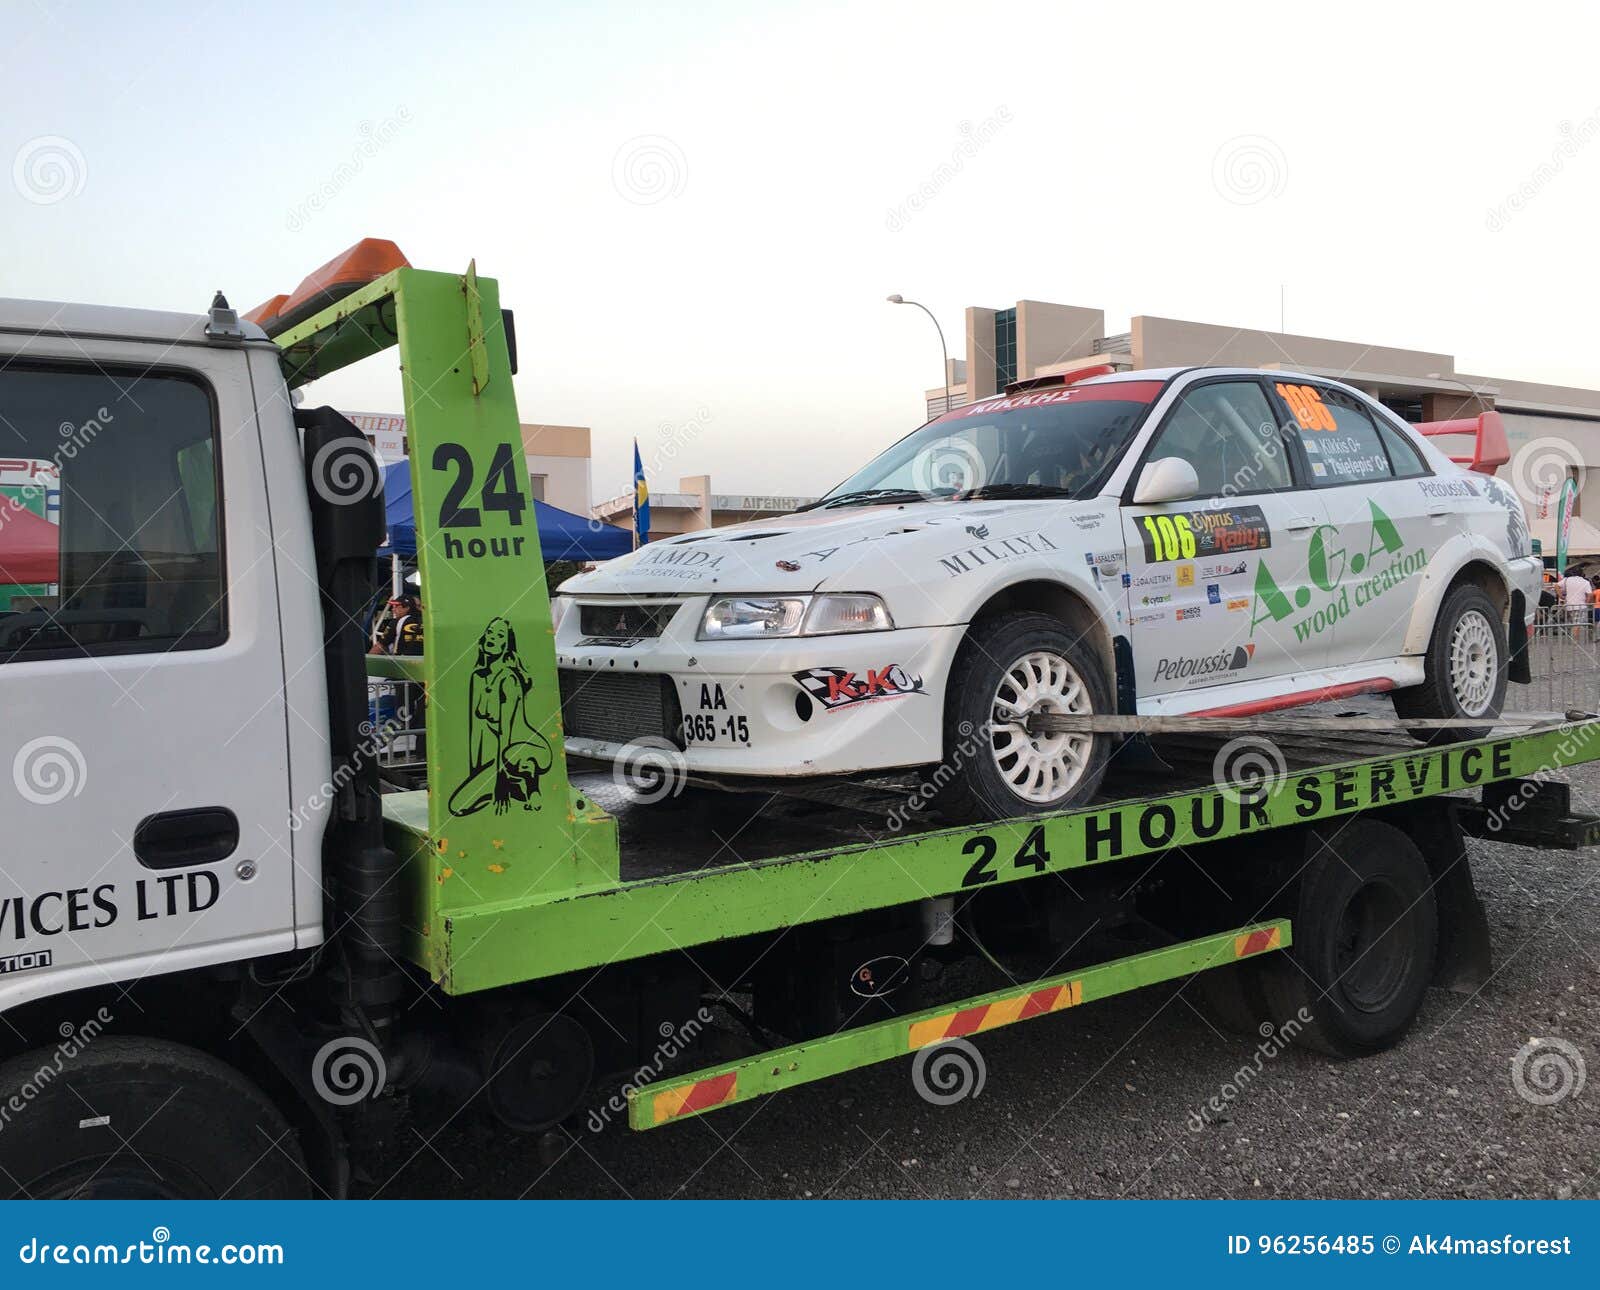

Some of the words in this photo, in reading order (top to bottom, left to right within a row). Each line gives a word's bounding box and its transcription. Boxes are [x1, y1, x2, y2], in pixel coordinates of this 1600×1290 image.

[1275, 383, 1337, 432] 106
[1319, 439, 1348, 455] Kikkis
[432, 443, 526, 528] 24
[743, 497, 799, 509] ΔΙΓΕΝΗΣ
[1144, 514, 1197, 562] 106
[1192, 512, 1234, 534] Cyprus
[1215, 526, 1259, 553] Rally
[443, 533, 525, 559] hour
[937, 532, 1060, 577] MILLYA
[1250, 497, 1404, 638] A.G.A
[1293, 585, 1350, 643] wood
[1354, 547, 1428, 607] creation
[1153, 649, 1232, 683] Petoussis
[700, 683, 727, 709] AA
[684, 714, 716, 741] 365
[961, 824, 1051, 888] 24
[1085, 786, 1271, 862] HOUR
[1295, 742, 1512, 818] SERVICE
[136, 870, 220, 921] LTD
